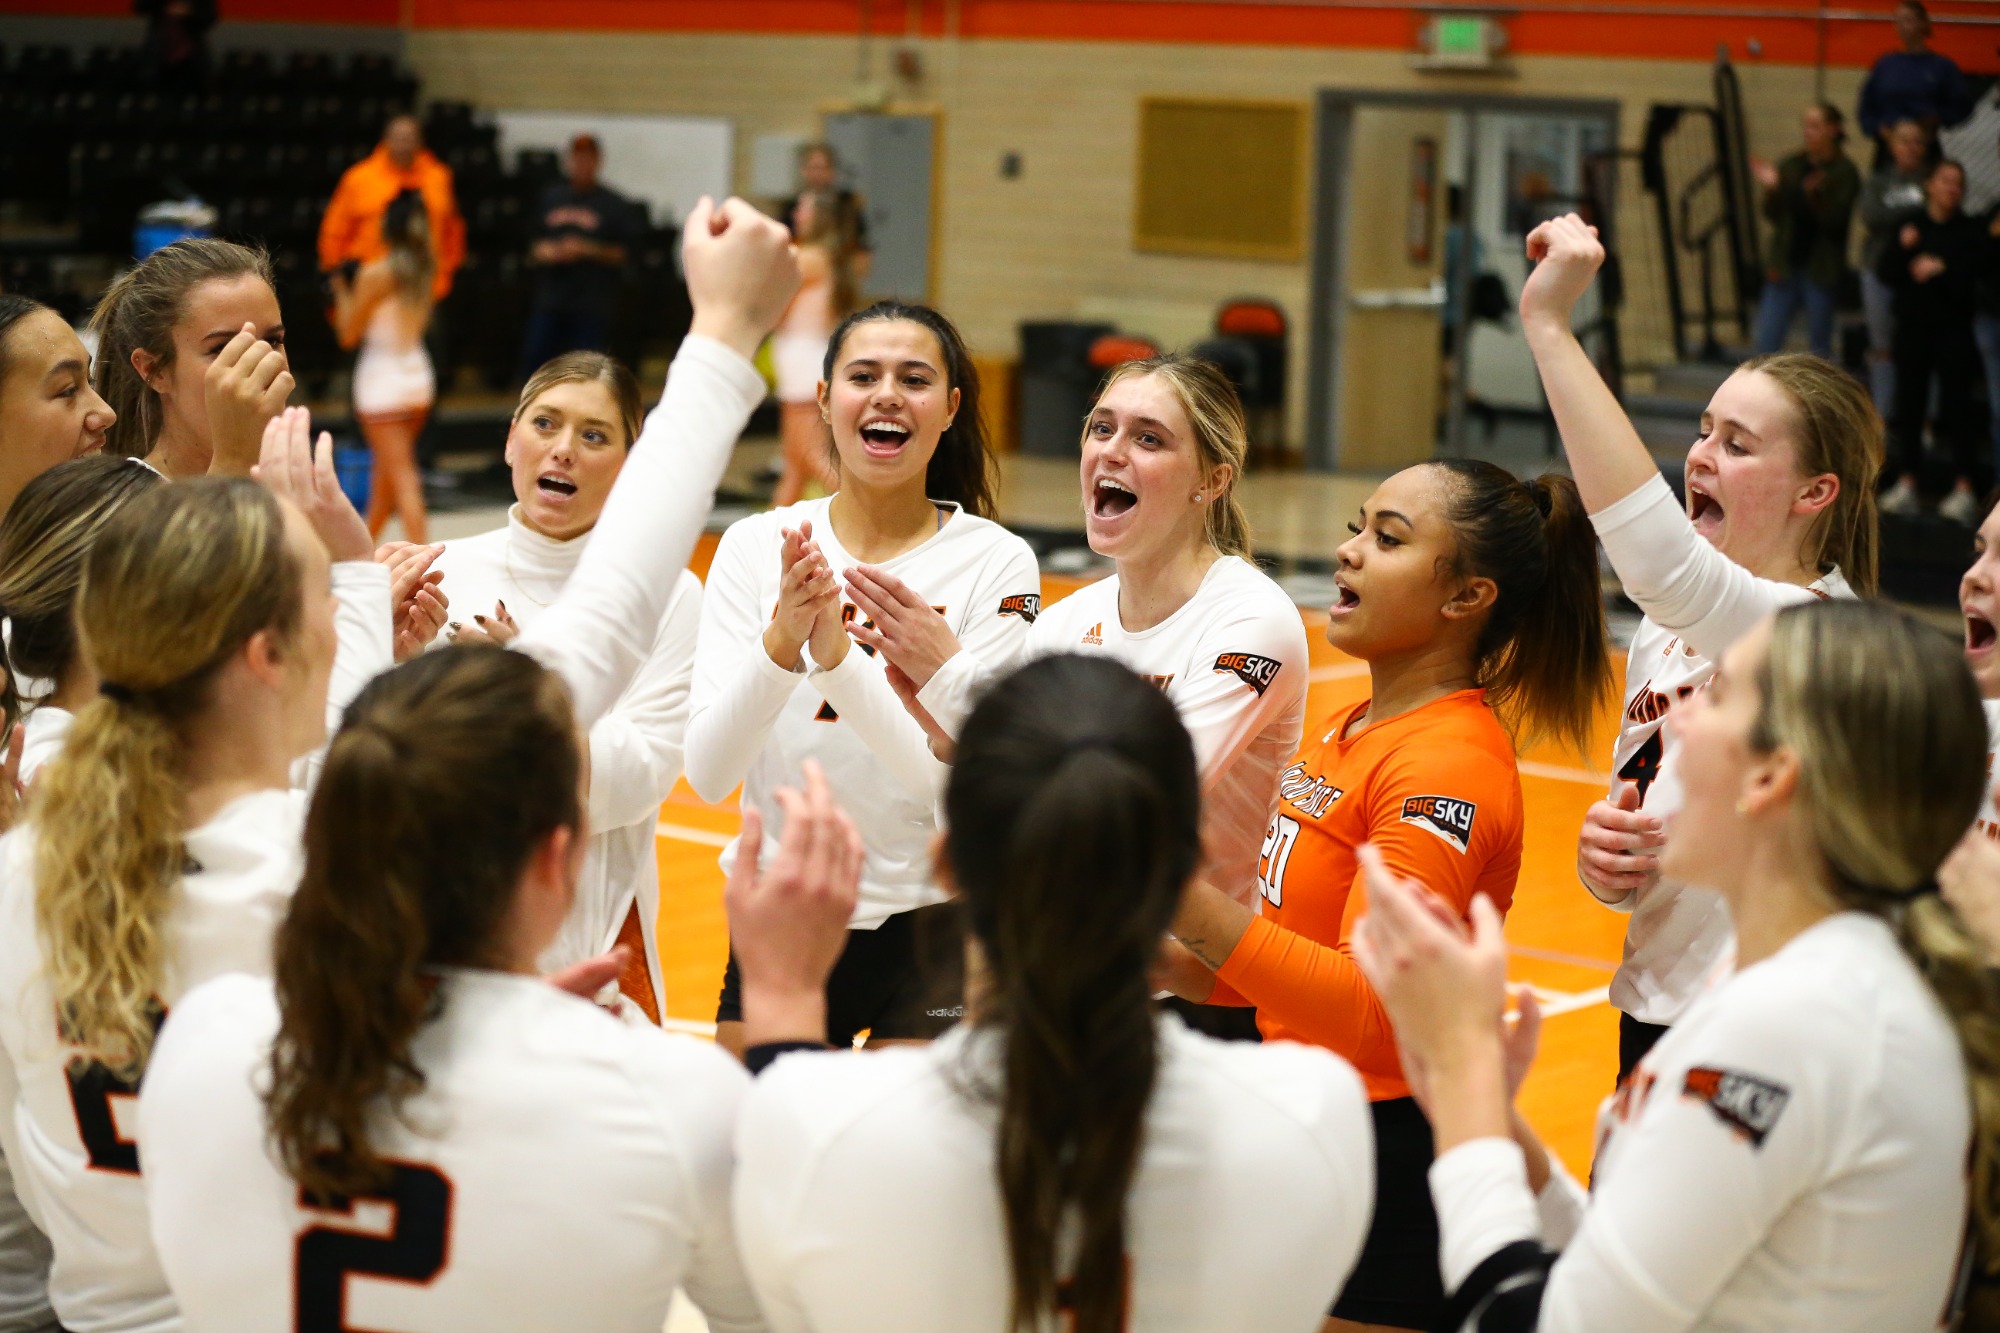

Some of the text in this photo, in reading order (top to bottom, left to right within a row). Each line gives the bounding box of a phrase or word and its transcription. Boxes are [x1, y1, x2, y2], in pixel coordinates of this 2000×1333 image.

[1617, 727, 1663, 811] 4
[926, 1006, 968, 1017] adida
[293, 1152, 457, 1333] 2
